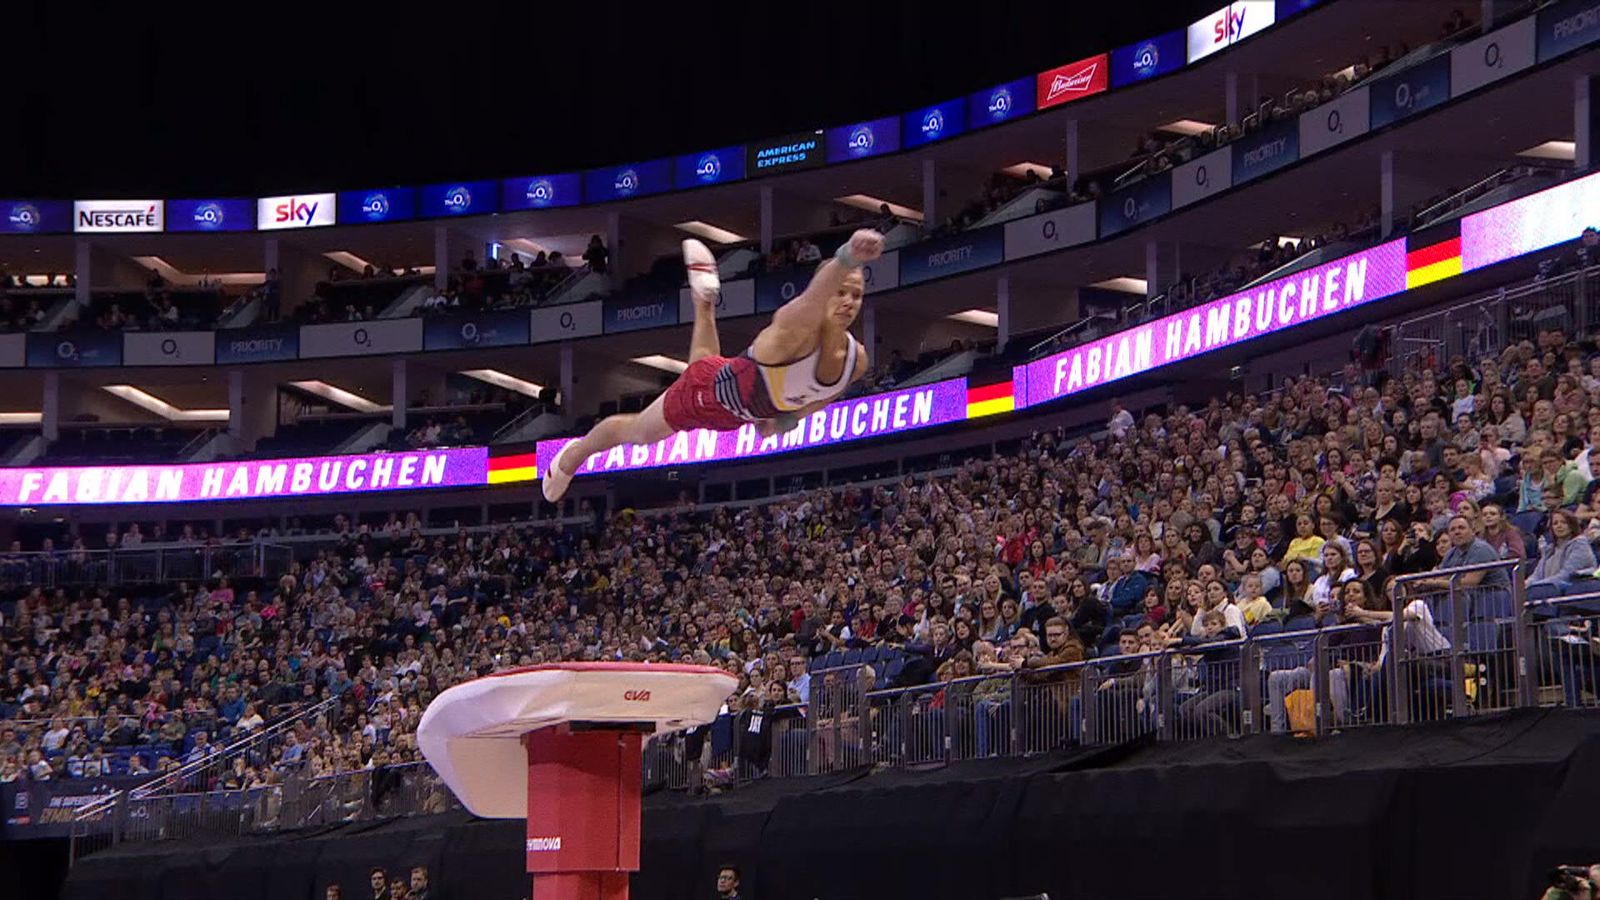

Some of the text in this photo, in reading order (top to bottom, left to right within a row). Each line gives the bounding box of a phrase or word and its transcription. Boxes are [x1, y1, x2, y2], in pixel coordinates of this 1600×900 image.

[1214, 7, 1246, 43] sky
[756, 140, 816, 158] AMERICAN
[1244, 138, 1286, 168] PRIORITY
[757, 152, 806, 169] EXPRESS
[79, 206, 155, 227] NESCAFÉ
[276, 198, 319, 225] sky
[928, 246, 973, 267] PRIORITY
[617, 303, 664, 321] PRIORITY
[1053, 258, 1368, 395] FABIAN HAMBUCHEN
[231, 338, 283, 353] PRIORITY
[18, 455, 447, 503] FABIAN HAMBUCHEN
